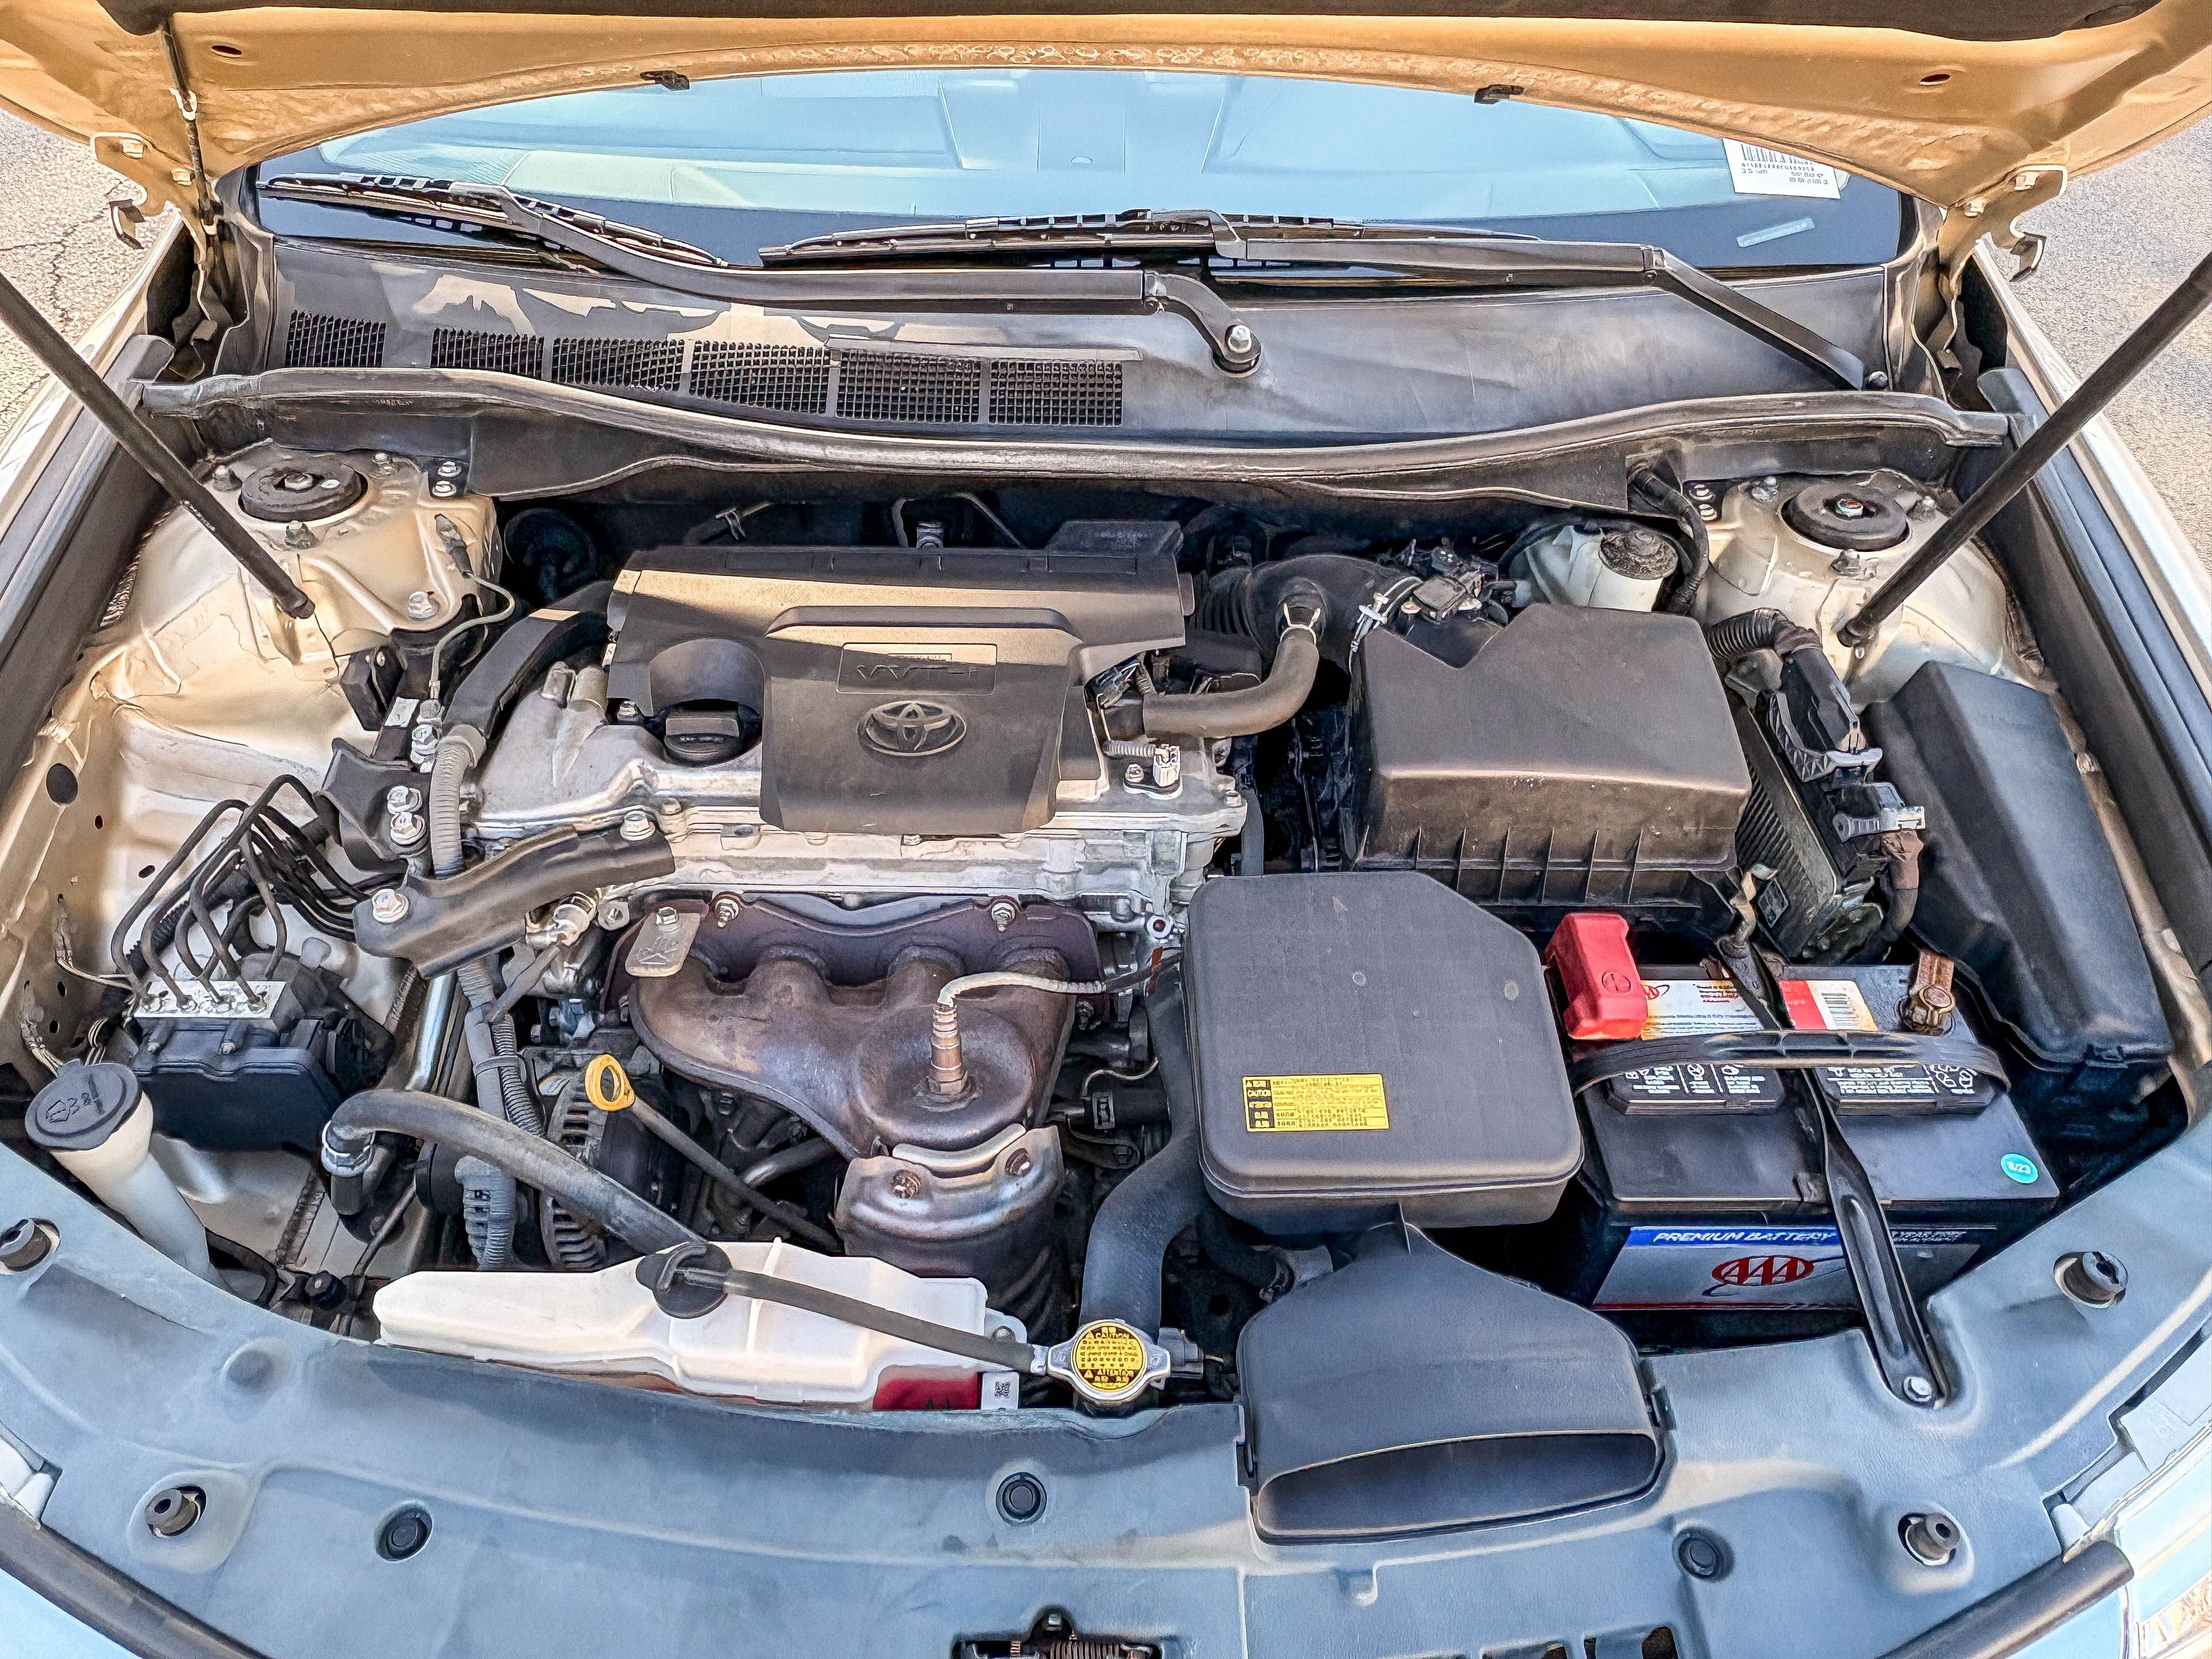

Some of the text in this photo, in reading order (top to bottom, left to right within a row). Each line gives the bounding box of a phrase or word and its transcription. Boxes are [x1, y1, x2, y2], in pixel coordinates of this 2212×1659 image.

[1654, 1232, 1836, 1243] PREMIUM BATTERY
[1713, 1255, 1813, 1286] AAA
